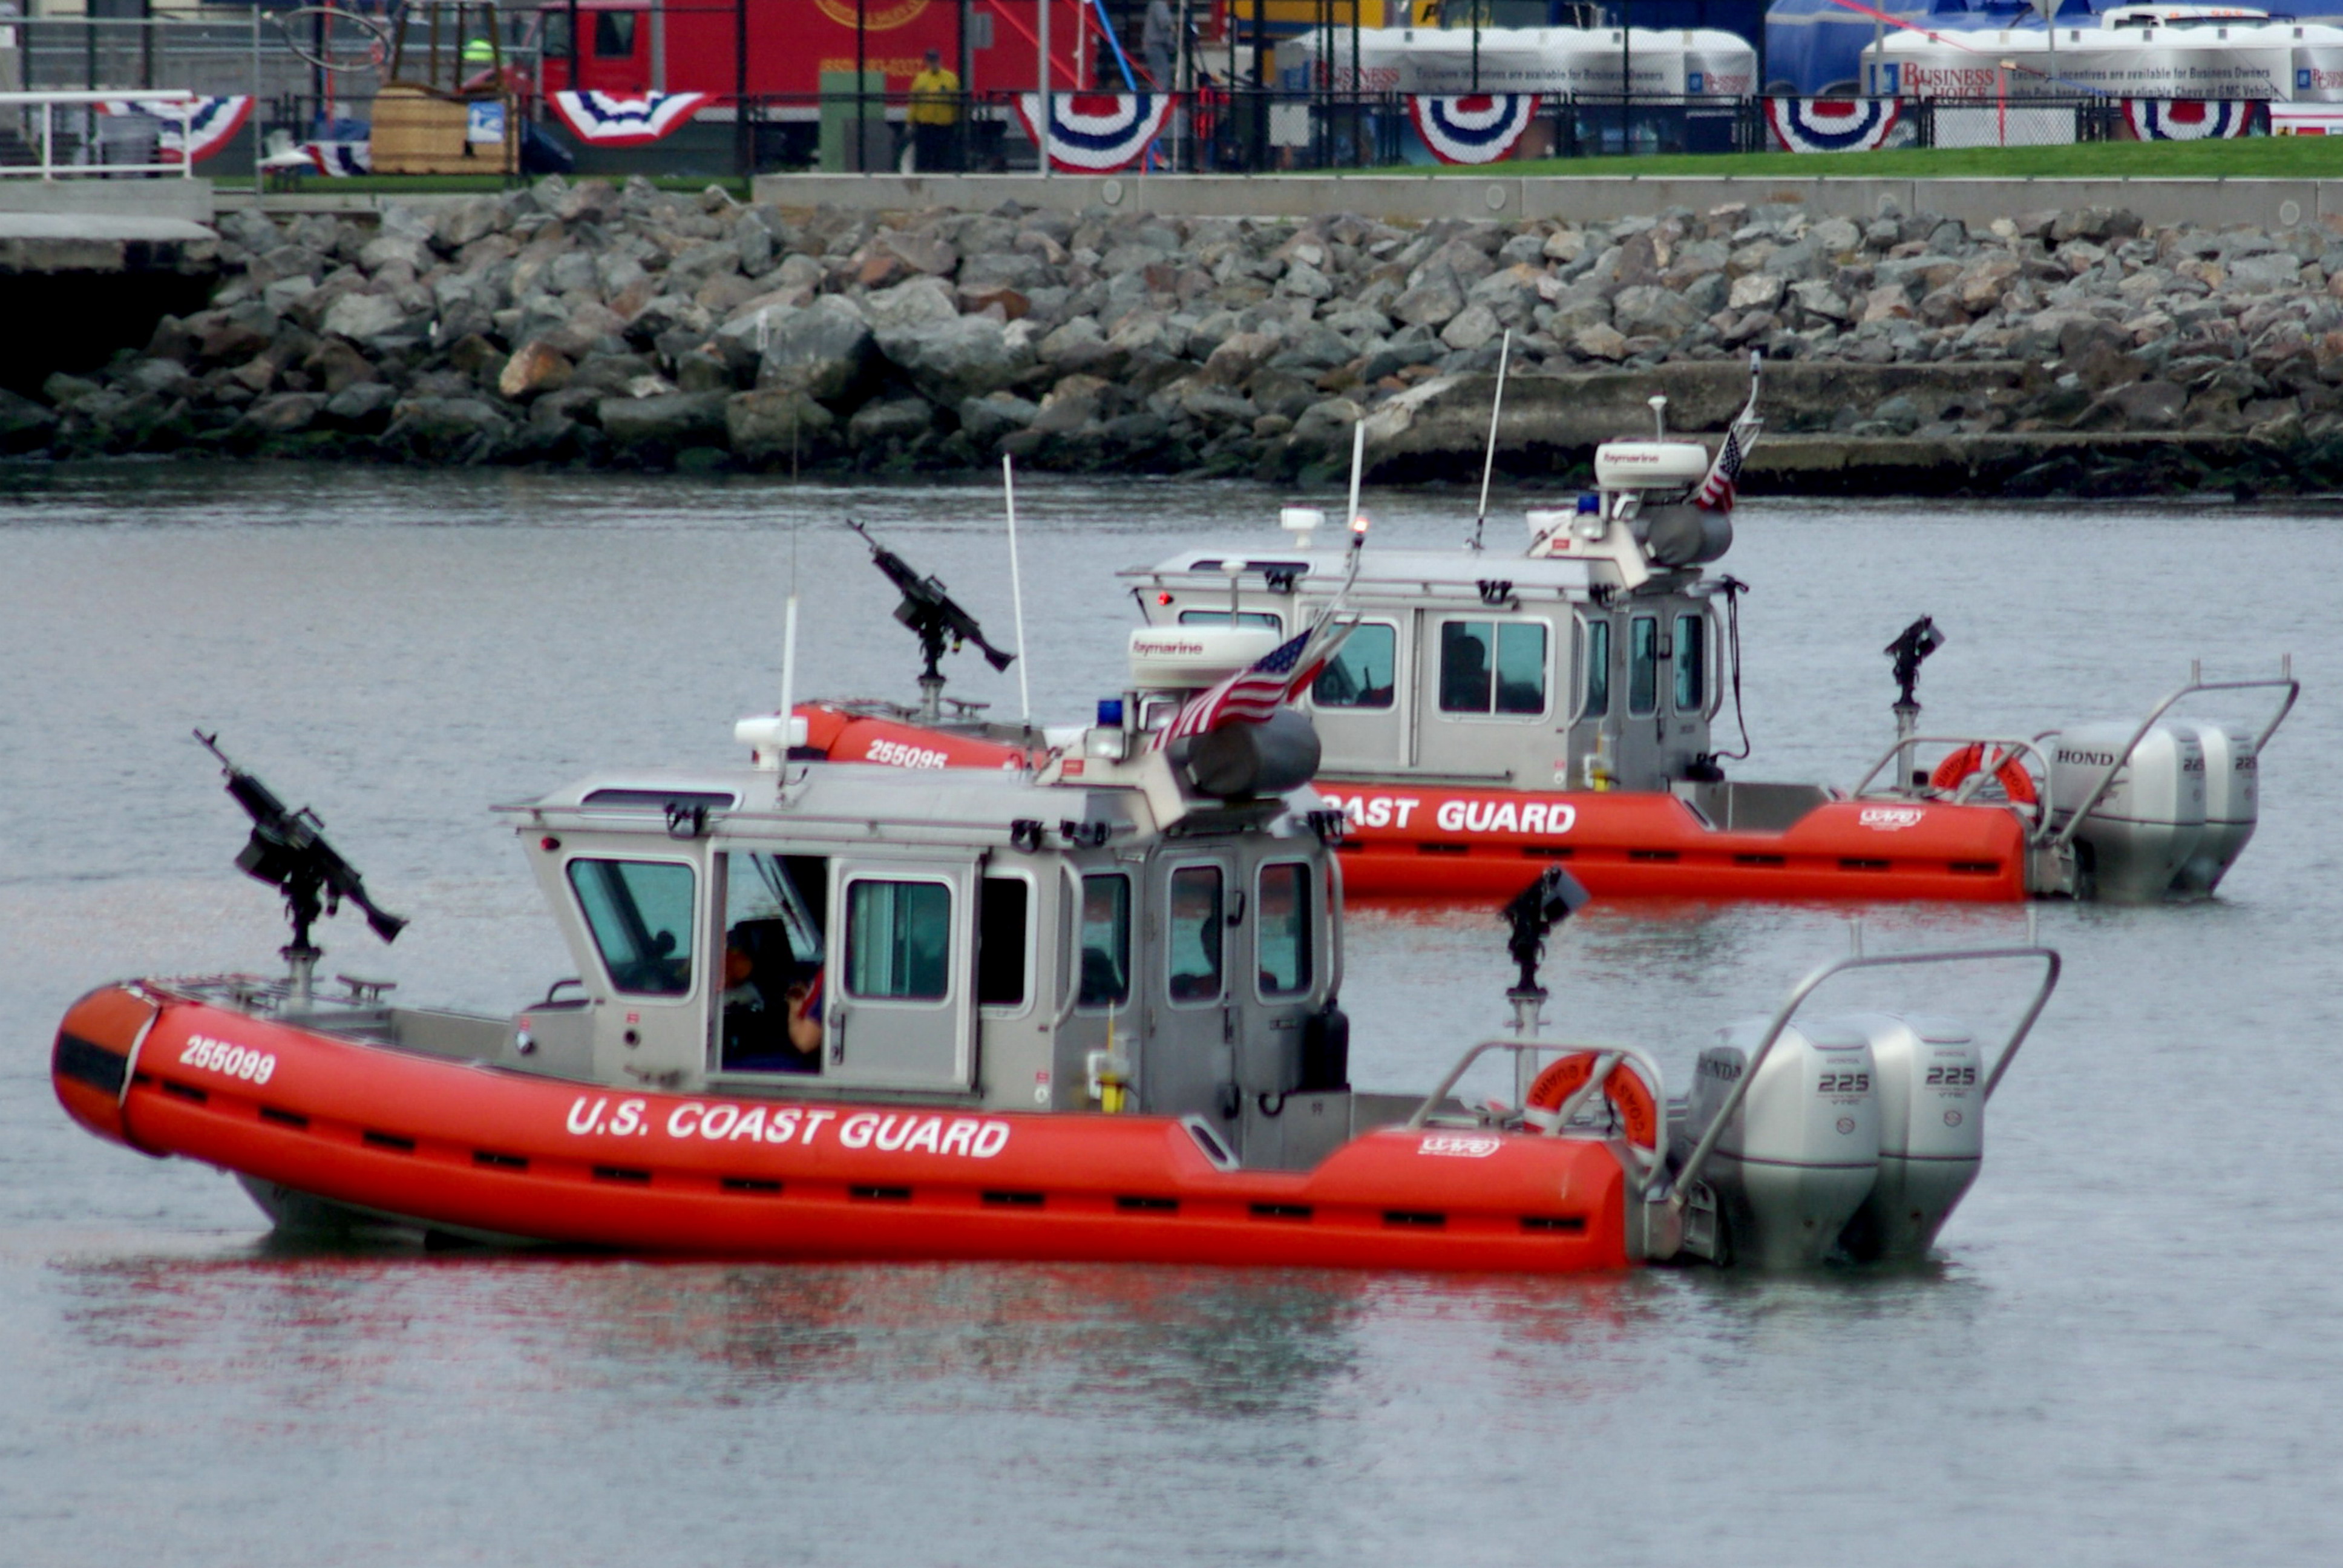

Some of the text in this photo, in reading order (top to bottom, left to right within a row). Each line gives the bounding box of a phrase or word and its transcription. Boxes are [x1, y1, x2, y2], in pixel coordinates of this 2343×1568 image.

[1902, 62, 1994, 87] BUSINESS
[2126, 67, 2171, 79] available
[2174, 67, 2187, 78] for
[2189, 67, 2232, 79] Business
[865, 739, 949, 769] 255095
[1437, 800, 1576, 834] GUARD
[179, 1034, 277, 1085] 255099
[1818, 1074, 1869, 1091] 225
[1925, 1067, 1975, 1085] 225
[566, 1096, 1010, 1158] U.S. COAST GUARD
